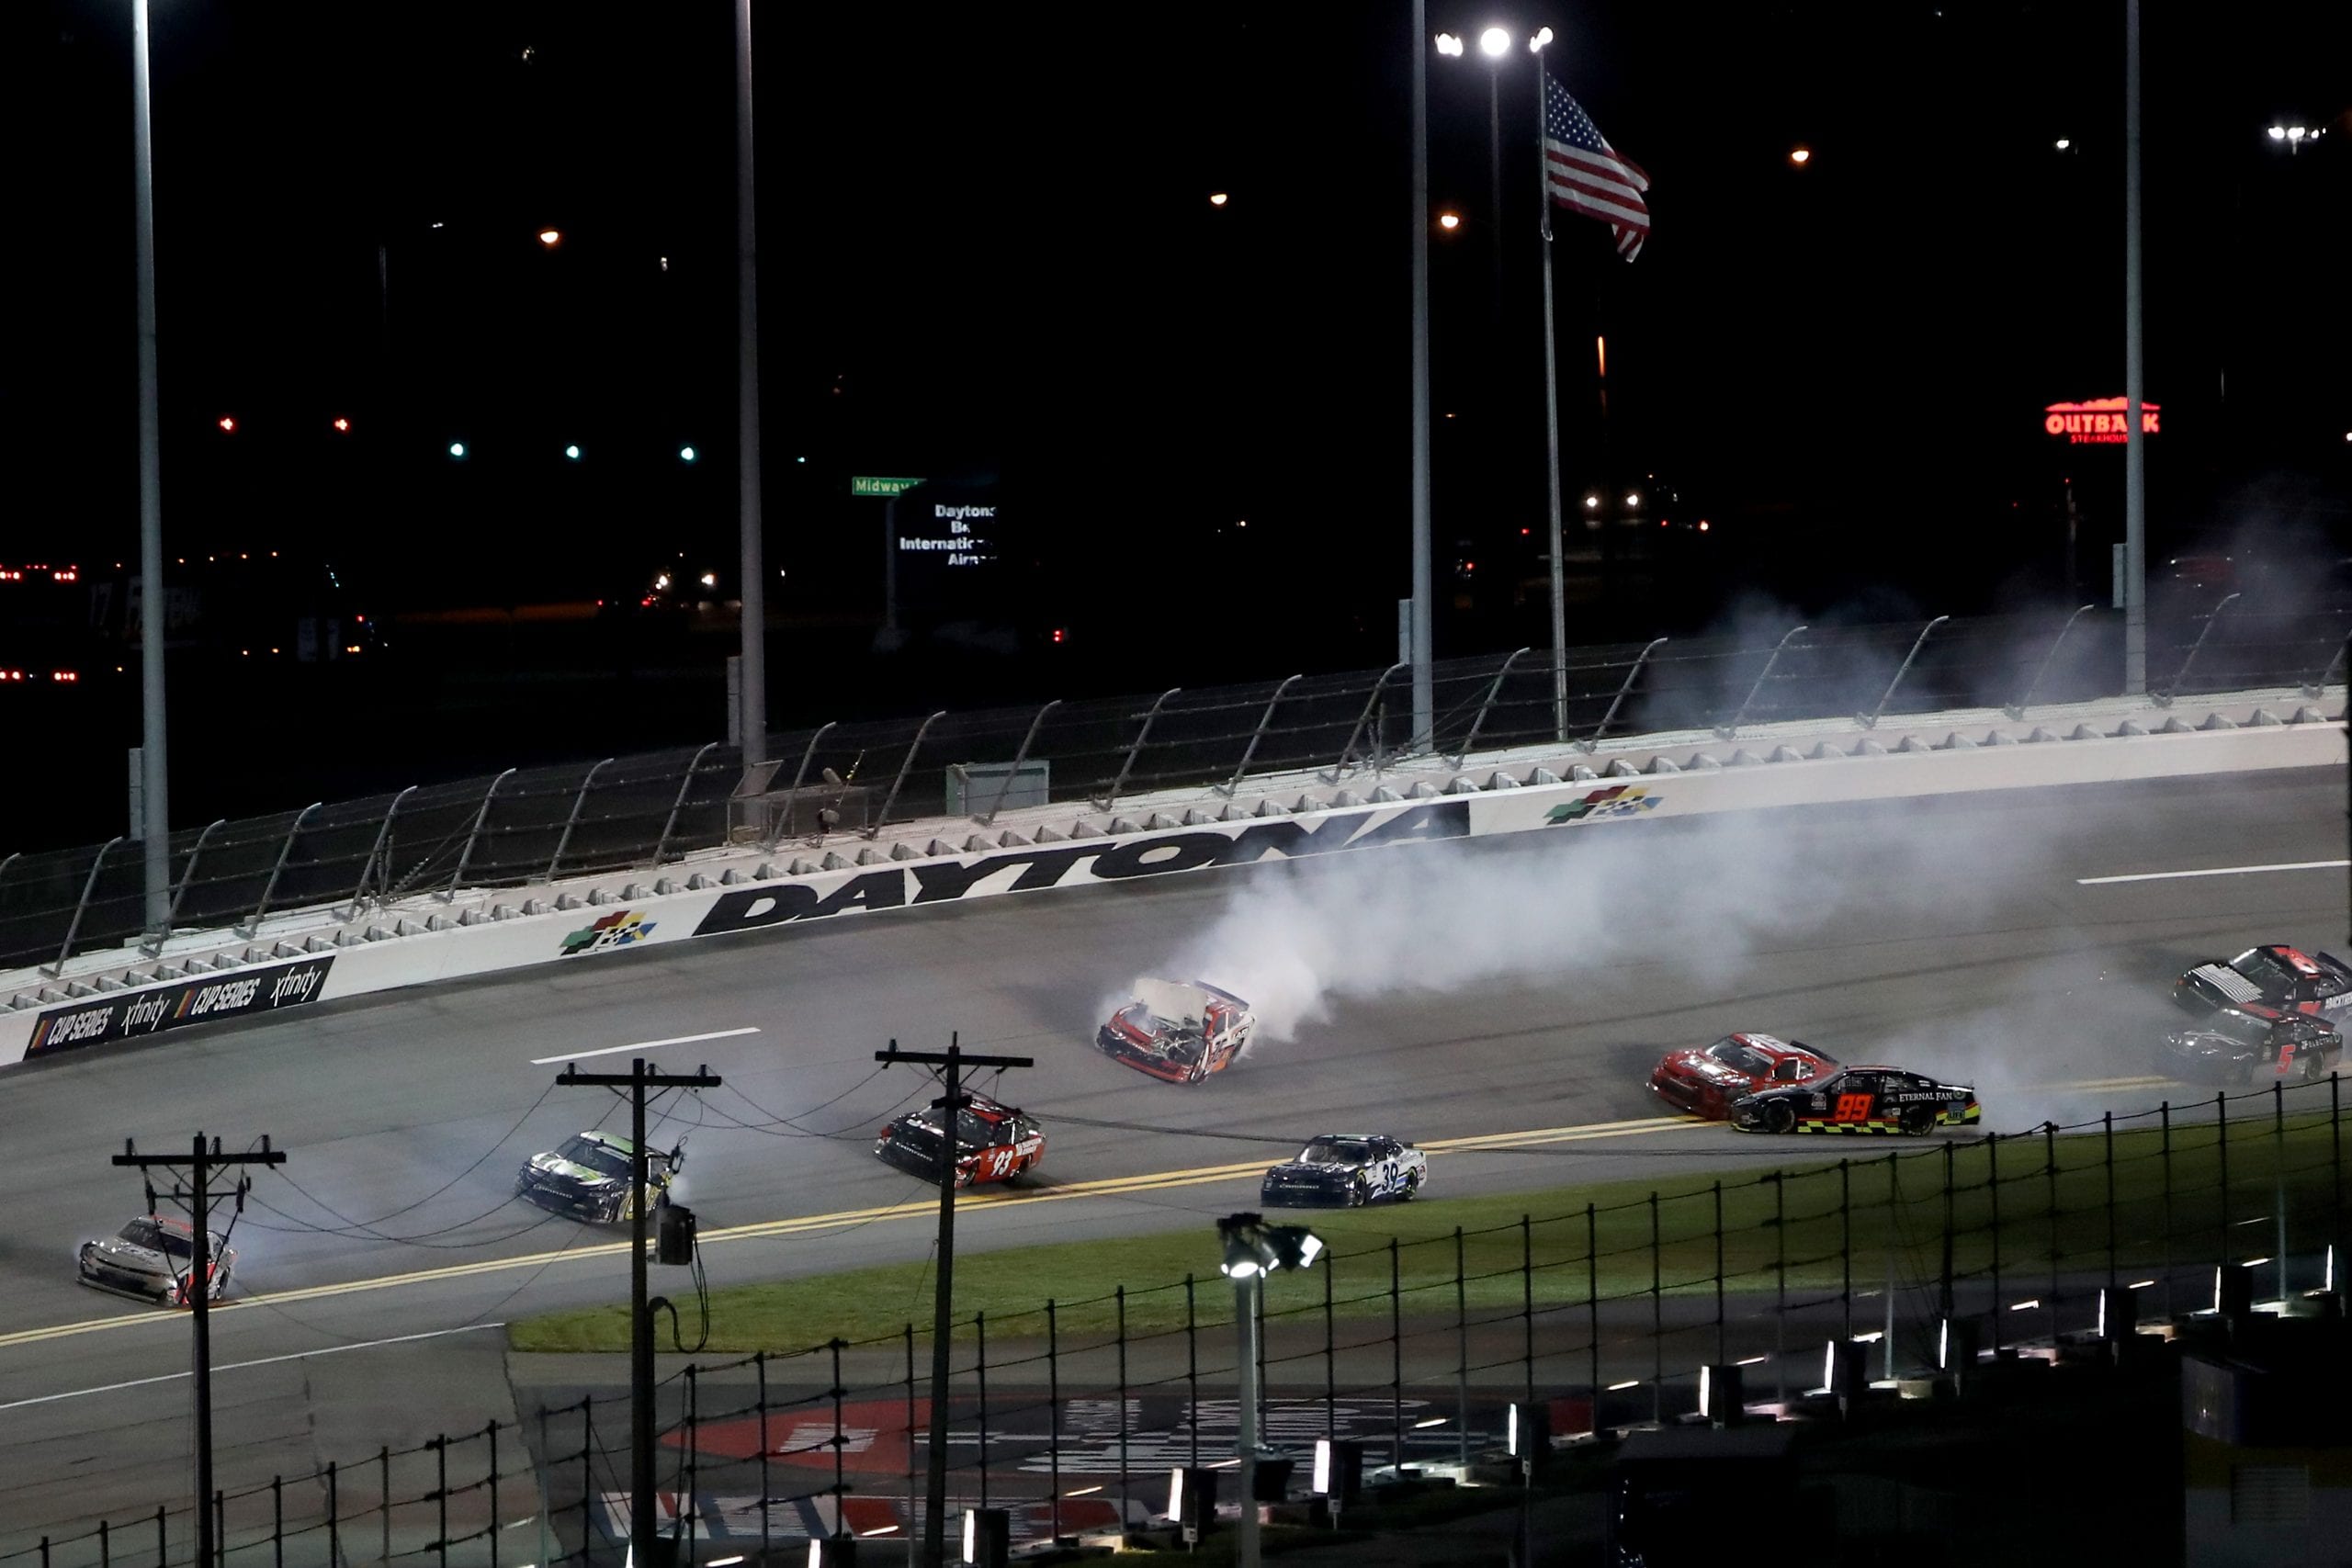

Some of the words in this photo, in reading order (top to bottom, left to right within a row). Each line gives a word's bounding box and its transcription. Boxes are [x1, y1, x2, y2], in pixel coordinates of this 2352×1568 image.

[2045, 413, 2160, 434] OUTBAK
[2071, 434, 2128, 444] STEAKHOUS
[691, 801, 1470, 936] DAYTONA
[269, 965, 322, 1007] xfinity
[120, 993, 171, 1035] xfinity
[1835, 1093, 1872, 1122] 99
[1899, 1092, 1934, 1102] ETERNAL
[1936, 1091, 1953, 1101] FAN
[991, 1150, 1013, 1176] 93
[1382, 1162, 1398, 1191] 39
